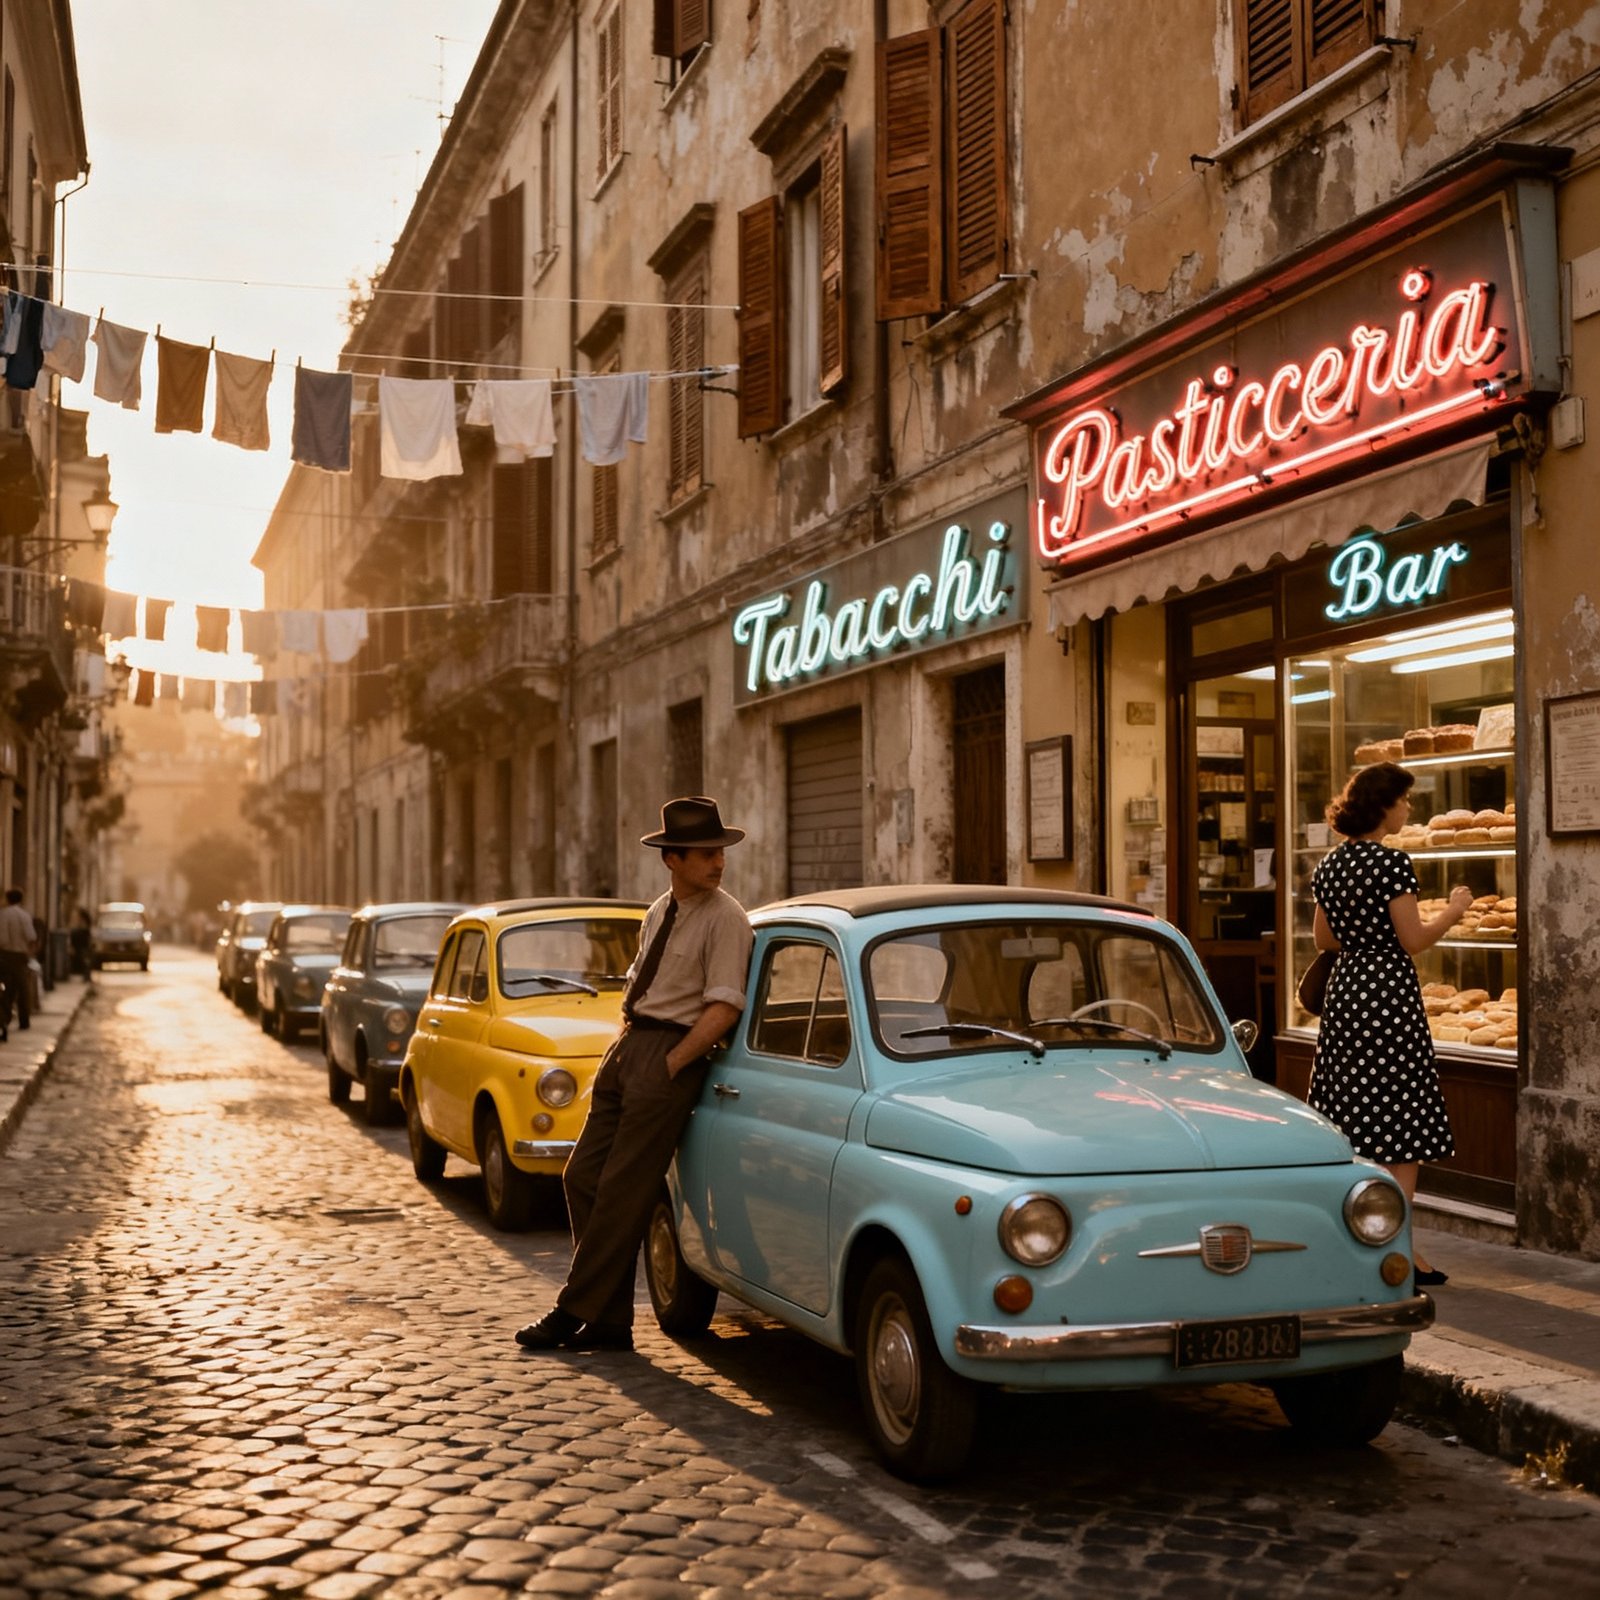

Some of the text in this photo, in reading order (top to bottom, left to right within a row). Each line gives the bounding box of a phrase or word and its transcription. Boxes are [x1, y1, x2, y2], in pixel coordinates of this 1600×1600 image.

[1044, 271, 1498, 540] Pasticceria
[733, 521, 1010, 692] Tabacchi
[1325, 539, 1468, 618] Bar
